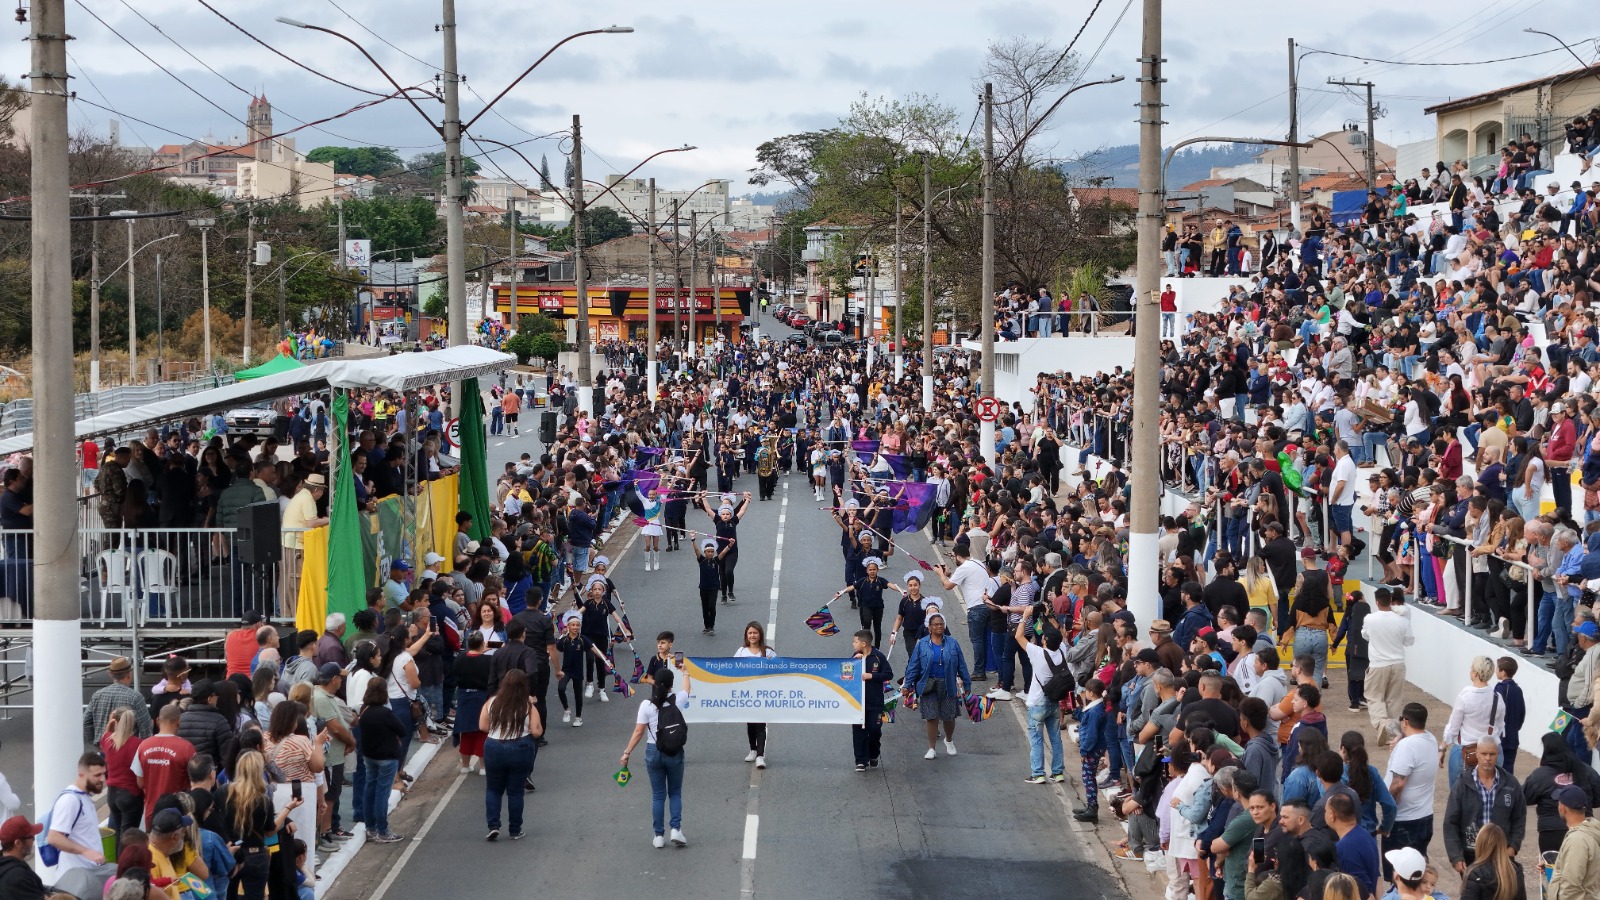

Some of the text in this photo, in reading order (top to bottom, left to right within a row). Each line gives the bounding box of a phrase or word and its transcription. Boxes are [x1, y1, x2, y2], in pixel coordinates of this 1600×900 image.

[705, 661, 828, 671] Projeto Musicalizando Bragança
[732, 690, 806, 699] E.M. PROF. DR.
[700, 699, 840, 709] FRANCISCO MURILO PINTO
